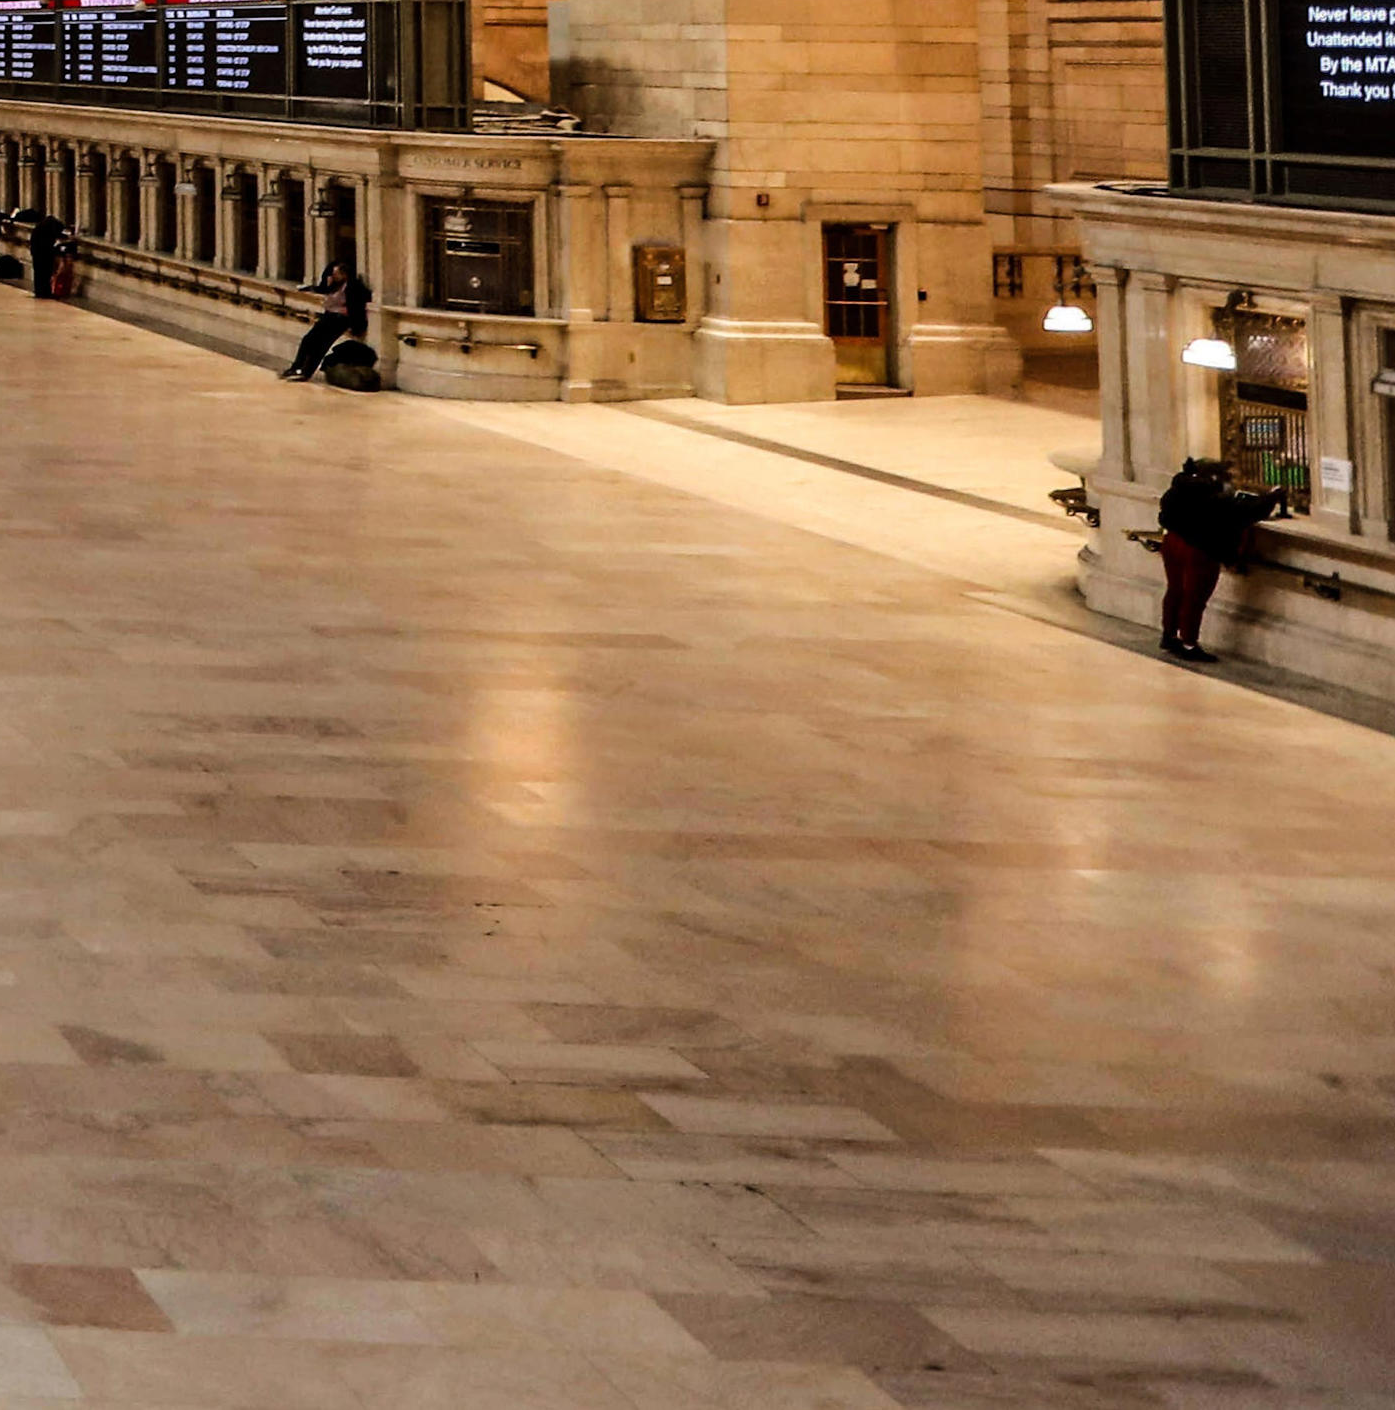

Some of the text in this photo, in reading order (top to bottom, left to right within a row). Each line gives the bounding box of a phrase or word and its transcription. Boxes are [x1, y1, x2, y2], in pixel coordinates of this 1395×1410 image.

[1308, 5, 1348, 23] Never
[1350, 5, 1387, 22] leave
[1306, 30, 1382, 48] Unattended
[1320, 56, 1339, 75] By
[1341, 56, 1363, 73] the
[1320, 81, 1362, 98] Thank
[1364, 85, 1390, 102] you
